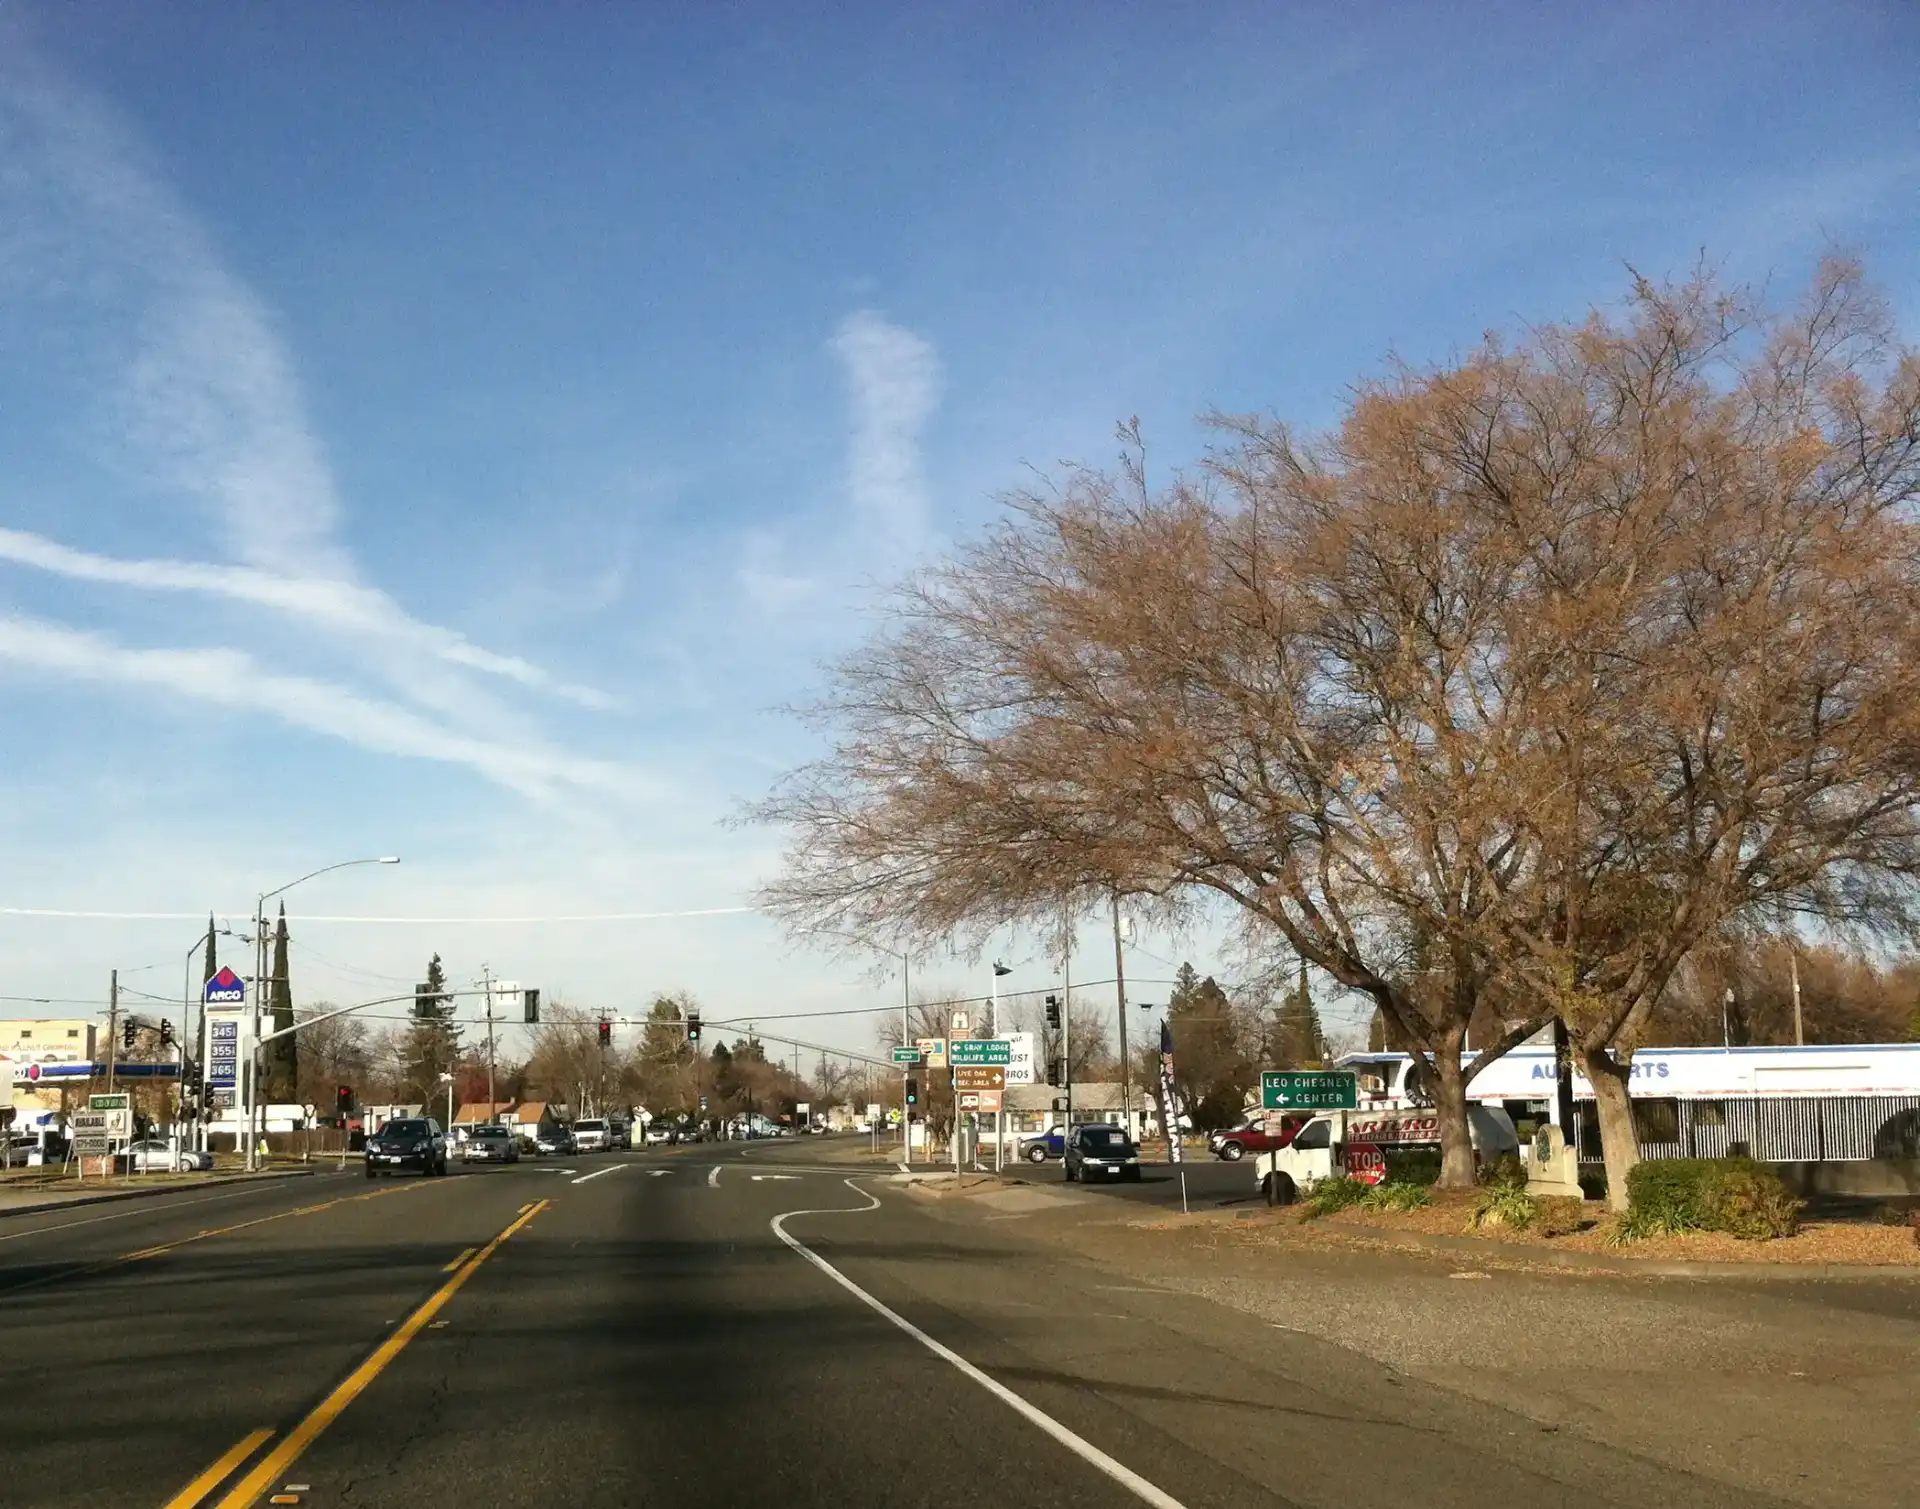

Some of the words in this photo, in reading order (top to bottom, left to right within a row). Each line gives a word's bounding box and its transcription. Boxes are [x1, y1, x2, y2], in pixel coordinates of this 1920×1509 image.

[209, 990, 241, 1001] ARCO
[964, 1043, 982, 1051] GRAY
[987, 1043, 1009, 1051] LODGE
[1266, 1078, 1288, 1088] LEO
[1294, 1078, 1351, 1088] CHESNEY
[1296, 1093, 1343, 1103] CENTER
[1347, 1152, 1382, 1170] STOP
